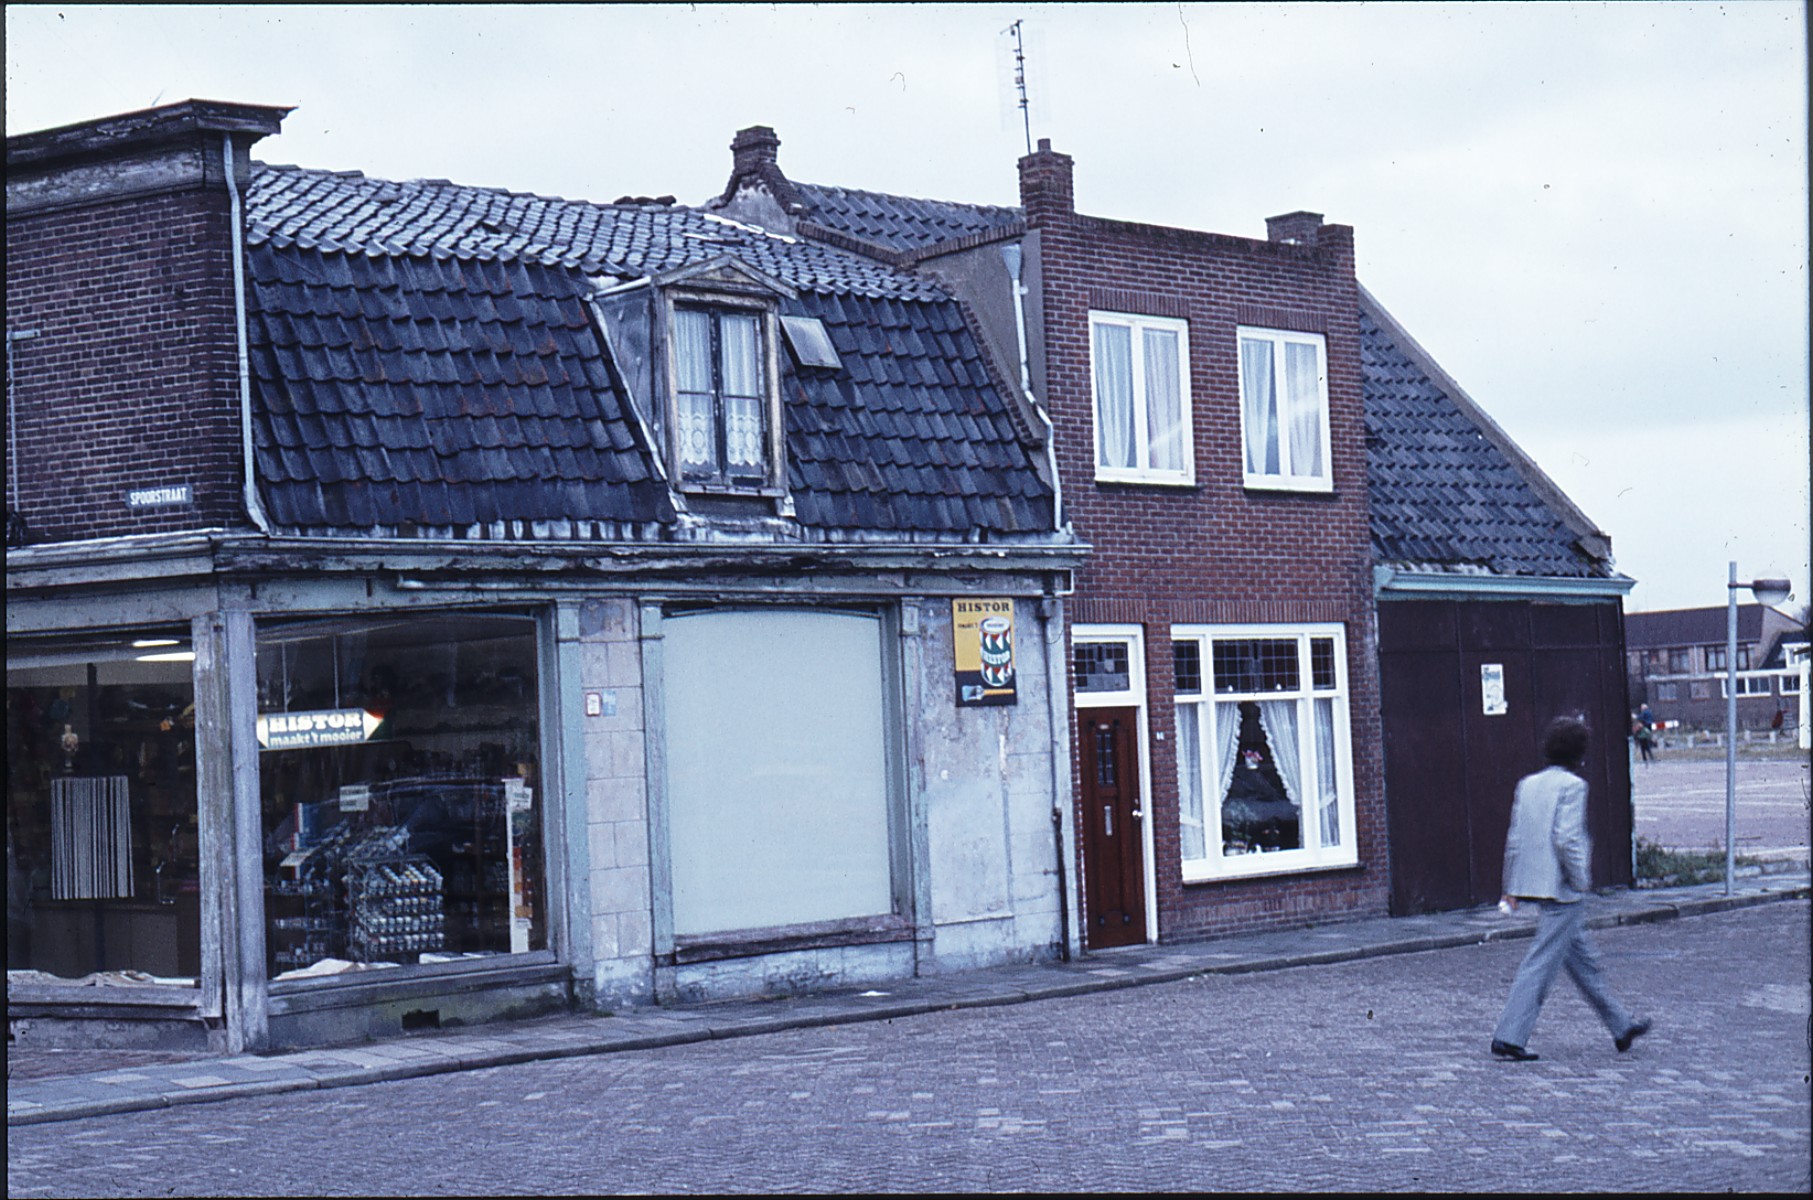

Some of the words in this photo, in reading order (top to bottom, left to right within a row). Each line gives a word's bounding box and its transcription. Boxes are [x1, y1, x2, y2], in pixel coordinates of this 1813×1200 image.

[130, 487, 187, 505] SPOORSTRAAT
[957, 602, 1010, 612] HISTOR
[269, 713, 362, 733] HISTOR
[269, 733, 310, 746] maakt
[320, 728, 363, 742] mooier
